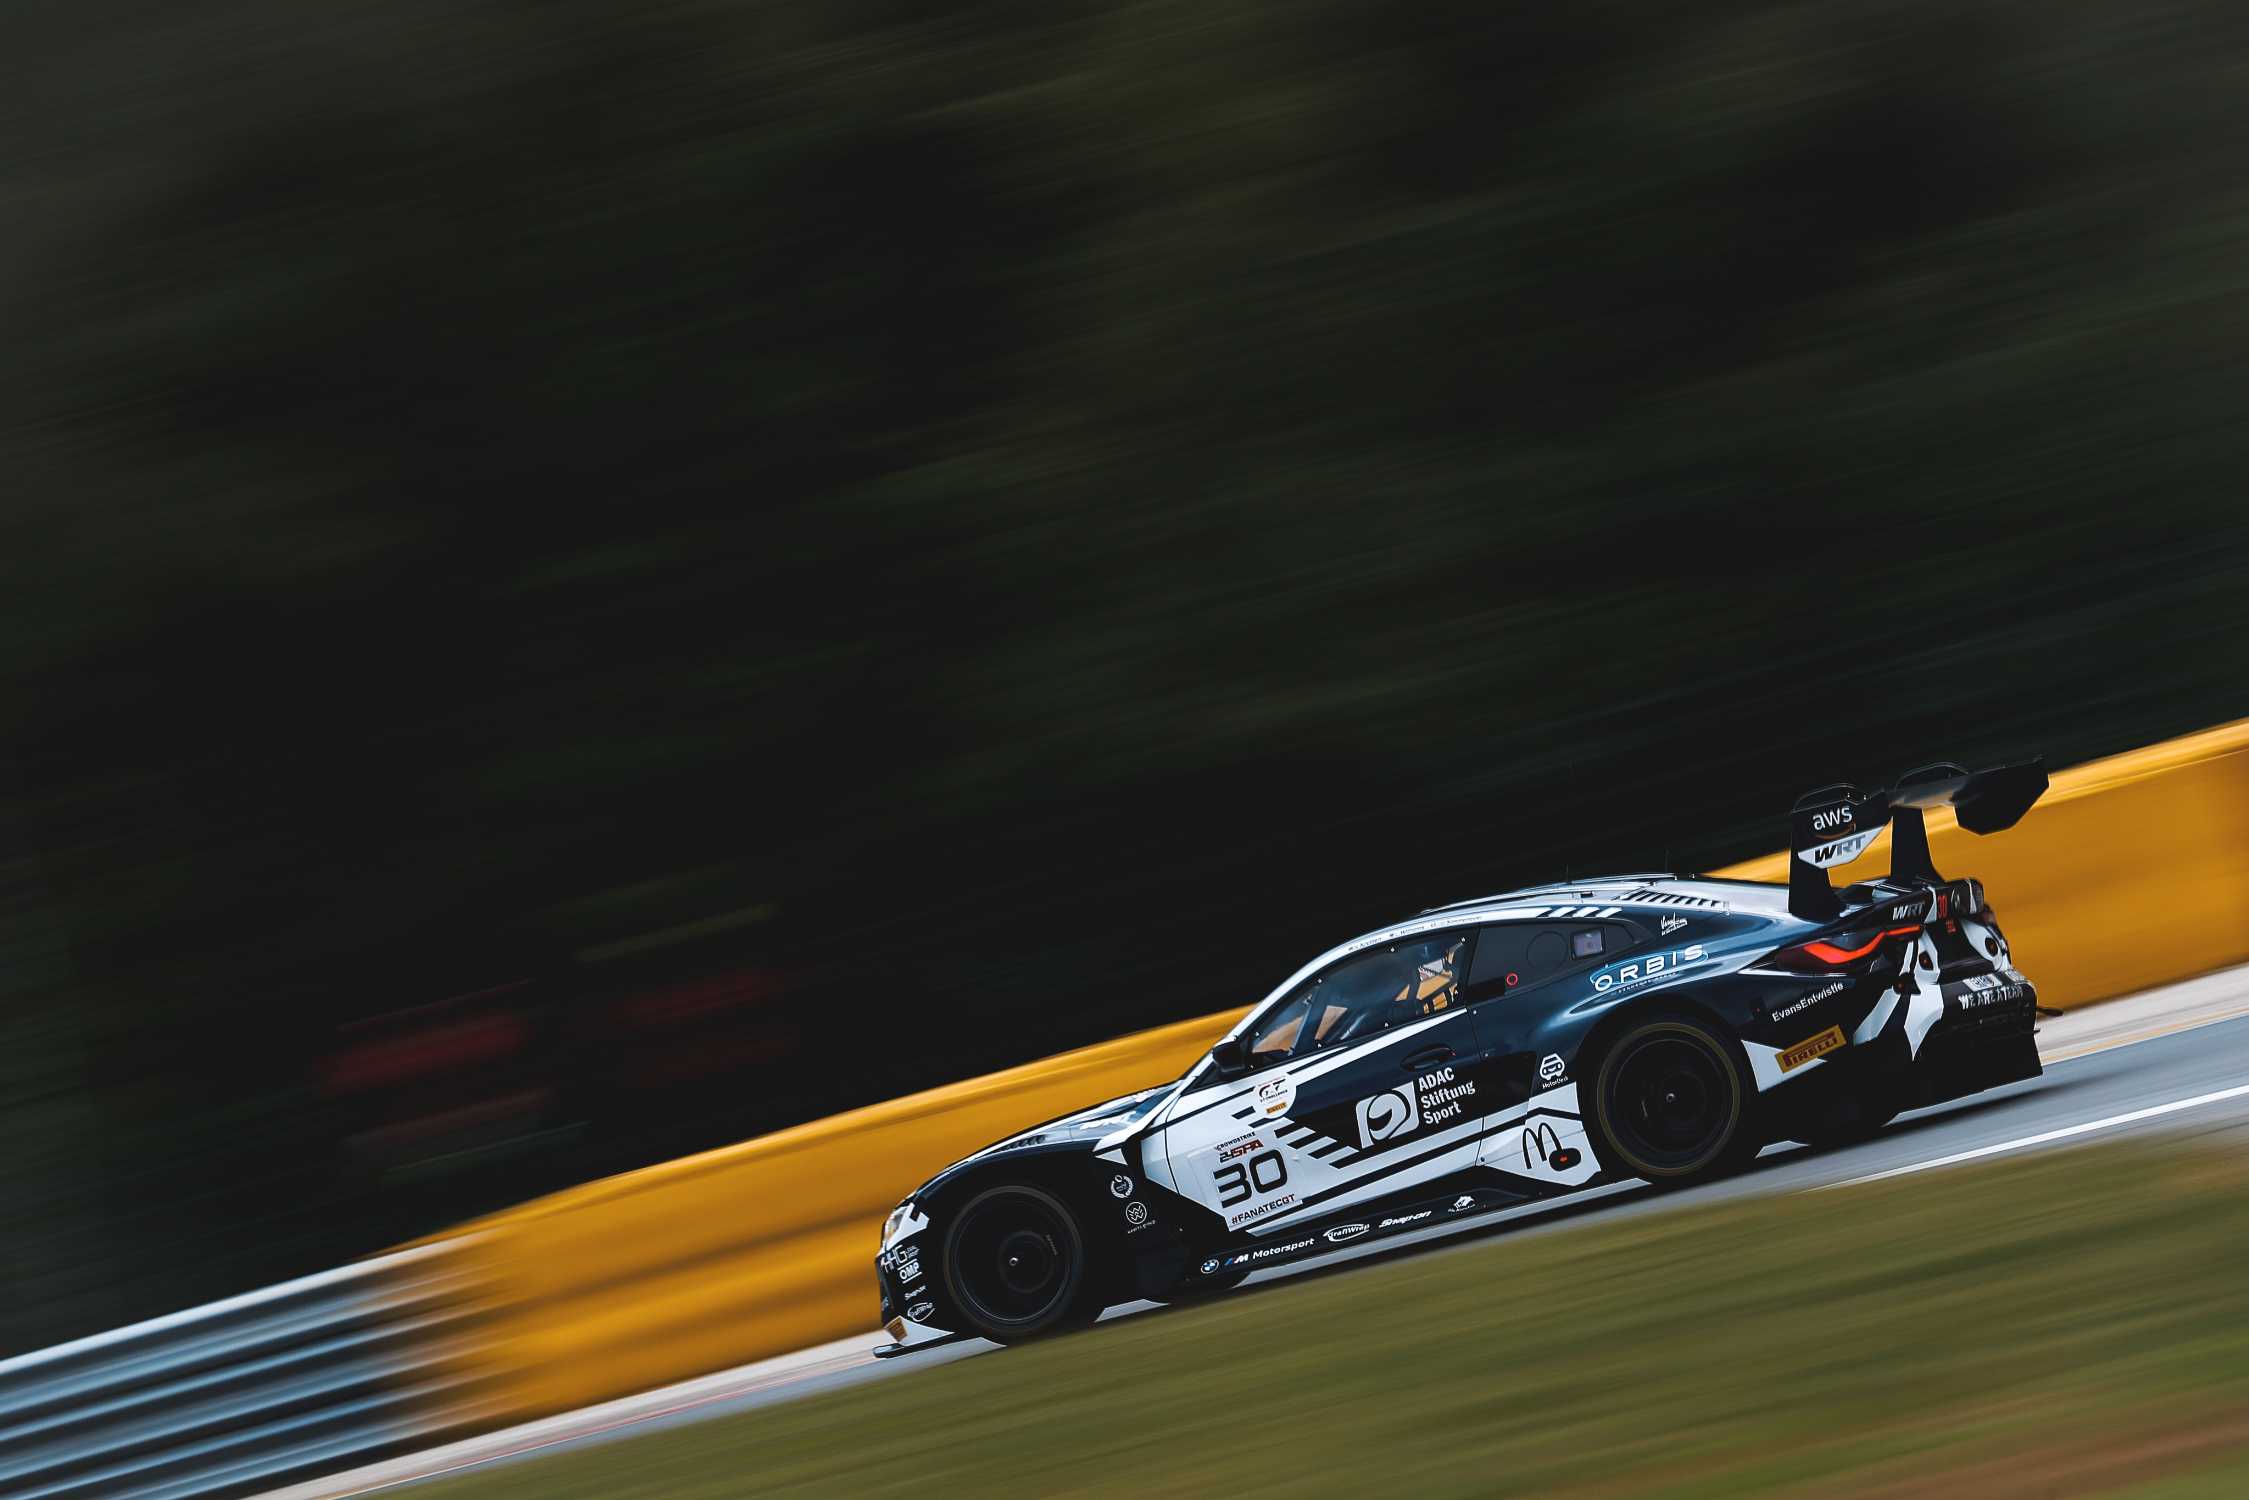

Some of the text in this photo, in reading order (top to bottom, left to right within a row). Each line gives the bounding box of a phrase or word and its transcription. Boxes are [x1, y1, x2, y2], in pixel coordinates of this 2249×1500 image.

[1812, 807, 1853, 831] aws
[1814, 834, 1866, 864] WRT
[1892, 901, 1926, 921] WRT
[1594, 944, 1703, 992] ORBIS
[1781, 1030, 1838, 1068] PIRELLI
[1418, 1066, 1455, 1092] ADAC
[1420, 1080, 1476, 1109] Stiftung
[1423, 1101, 1462, 1125] Sport
[1216, 1131, 1256, 1150] CROWDSTRIKE
[1213, 1149, 1288, 1209] 30
[1231, 1193, 1296, 1225] #FANATECGT
[1252, 1237, 1315, 1260] Motorsport
[899, 1261, 920, 1280] OMP
